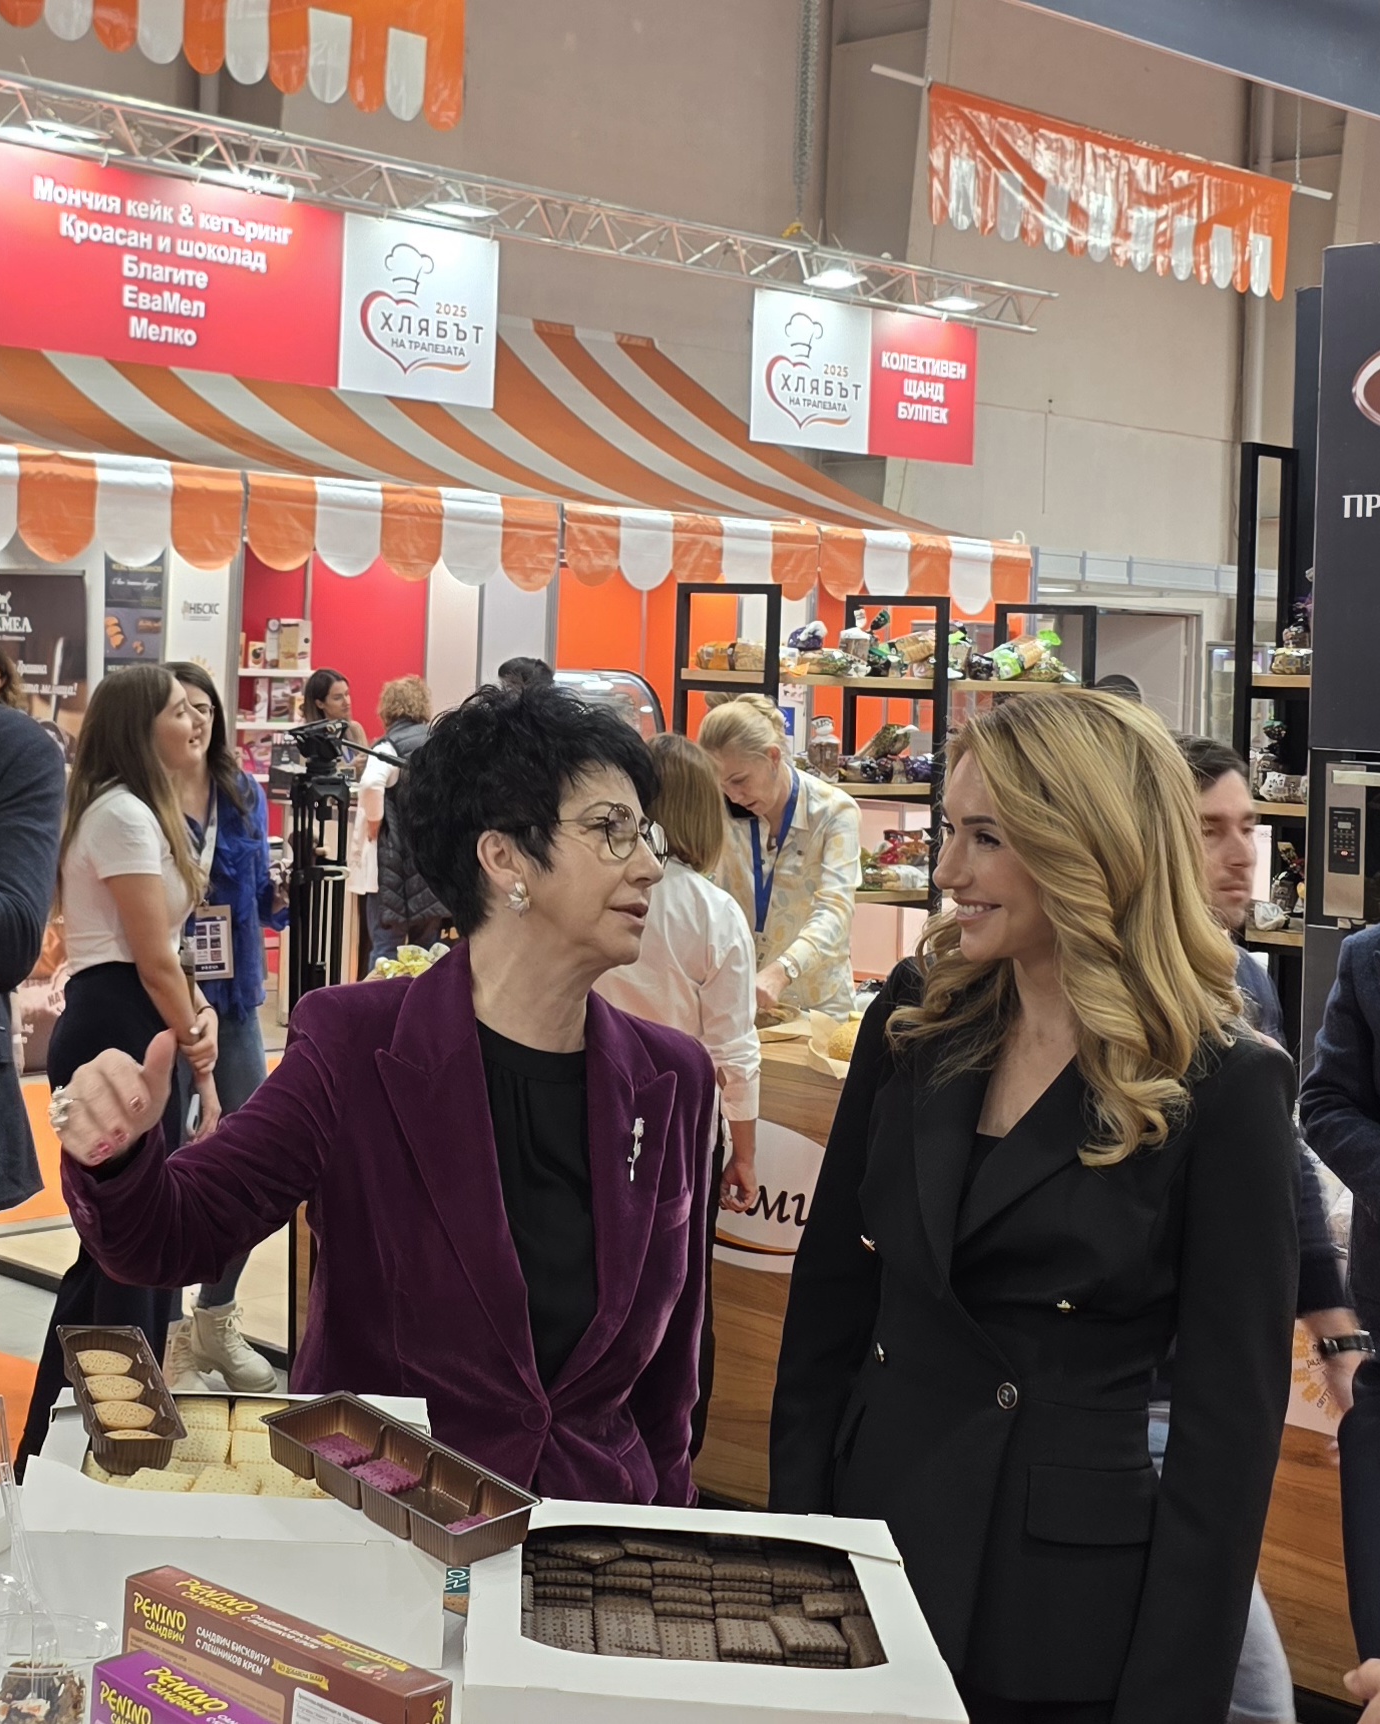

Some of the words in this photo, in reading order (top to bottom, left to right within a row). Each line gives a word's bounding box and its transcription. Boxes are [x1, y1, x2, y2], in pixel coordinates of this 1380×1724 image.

[33, 175, 121, 214] Мончия
[126, 199, 174, 225] кейк
[178, 204, 194, 227] &
[199, 210, 293, 246] кетъринг
[60, 212, 152, 250] Кроасан
[158, 236, 171, 253] и
[176, 239, 267, 273] шоколад
[122, 253, 208, 289] Благите
[122, 285, 206, 319] ЕваМел
[435, 302, 467, 318] 2025
[129, 316, 197, 346] Мелко
[380, 311, 484, 344] ХЛЯБЪТ
[391, 337, 406, 349] НА
[408, 340, 465, 357] ТРАПЕЗАТА
[823, 364, 849, 377] 2025
[881, 351, 967, 380] КОЛЕКТИВЕН
[780, 373, 862, 400] ХЛЯБЪТ
[903, 378, 945, 403] ЩАНД
[789, 396, 801, 407] НА
[803, 398, 847, 413] ТРАПЕЗАТА
[897, 402, 949, 425] БУЛПЕК
[133, 1591, 187, 1632] PENINO
[175, 1578, 259, 1613] PENINO
[144, 1619, 185, 1645] САНДВИЧ
[196, 1626, 231, 1649] САНДВИЧ
[231, 1641, 271, 1667] БИСКВИТИ
[195, 1638, 201, 1648] С
[201, 1641, 242, 1667] ЛЕШНИКОВ
[242, 1658, 263, 1676] КРЕМ
[99, 1680, 152, 1724] PENINO
[143, 1666, 229, 1712] PENINO
[146, 1682, 206, 1716] САНДВИЧ
